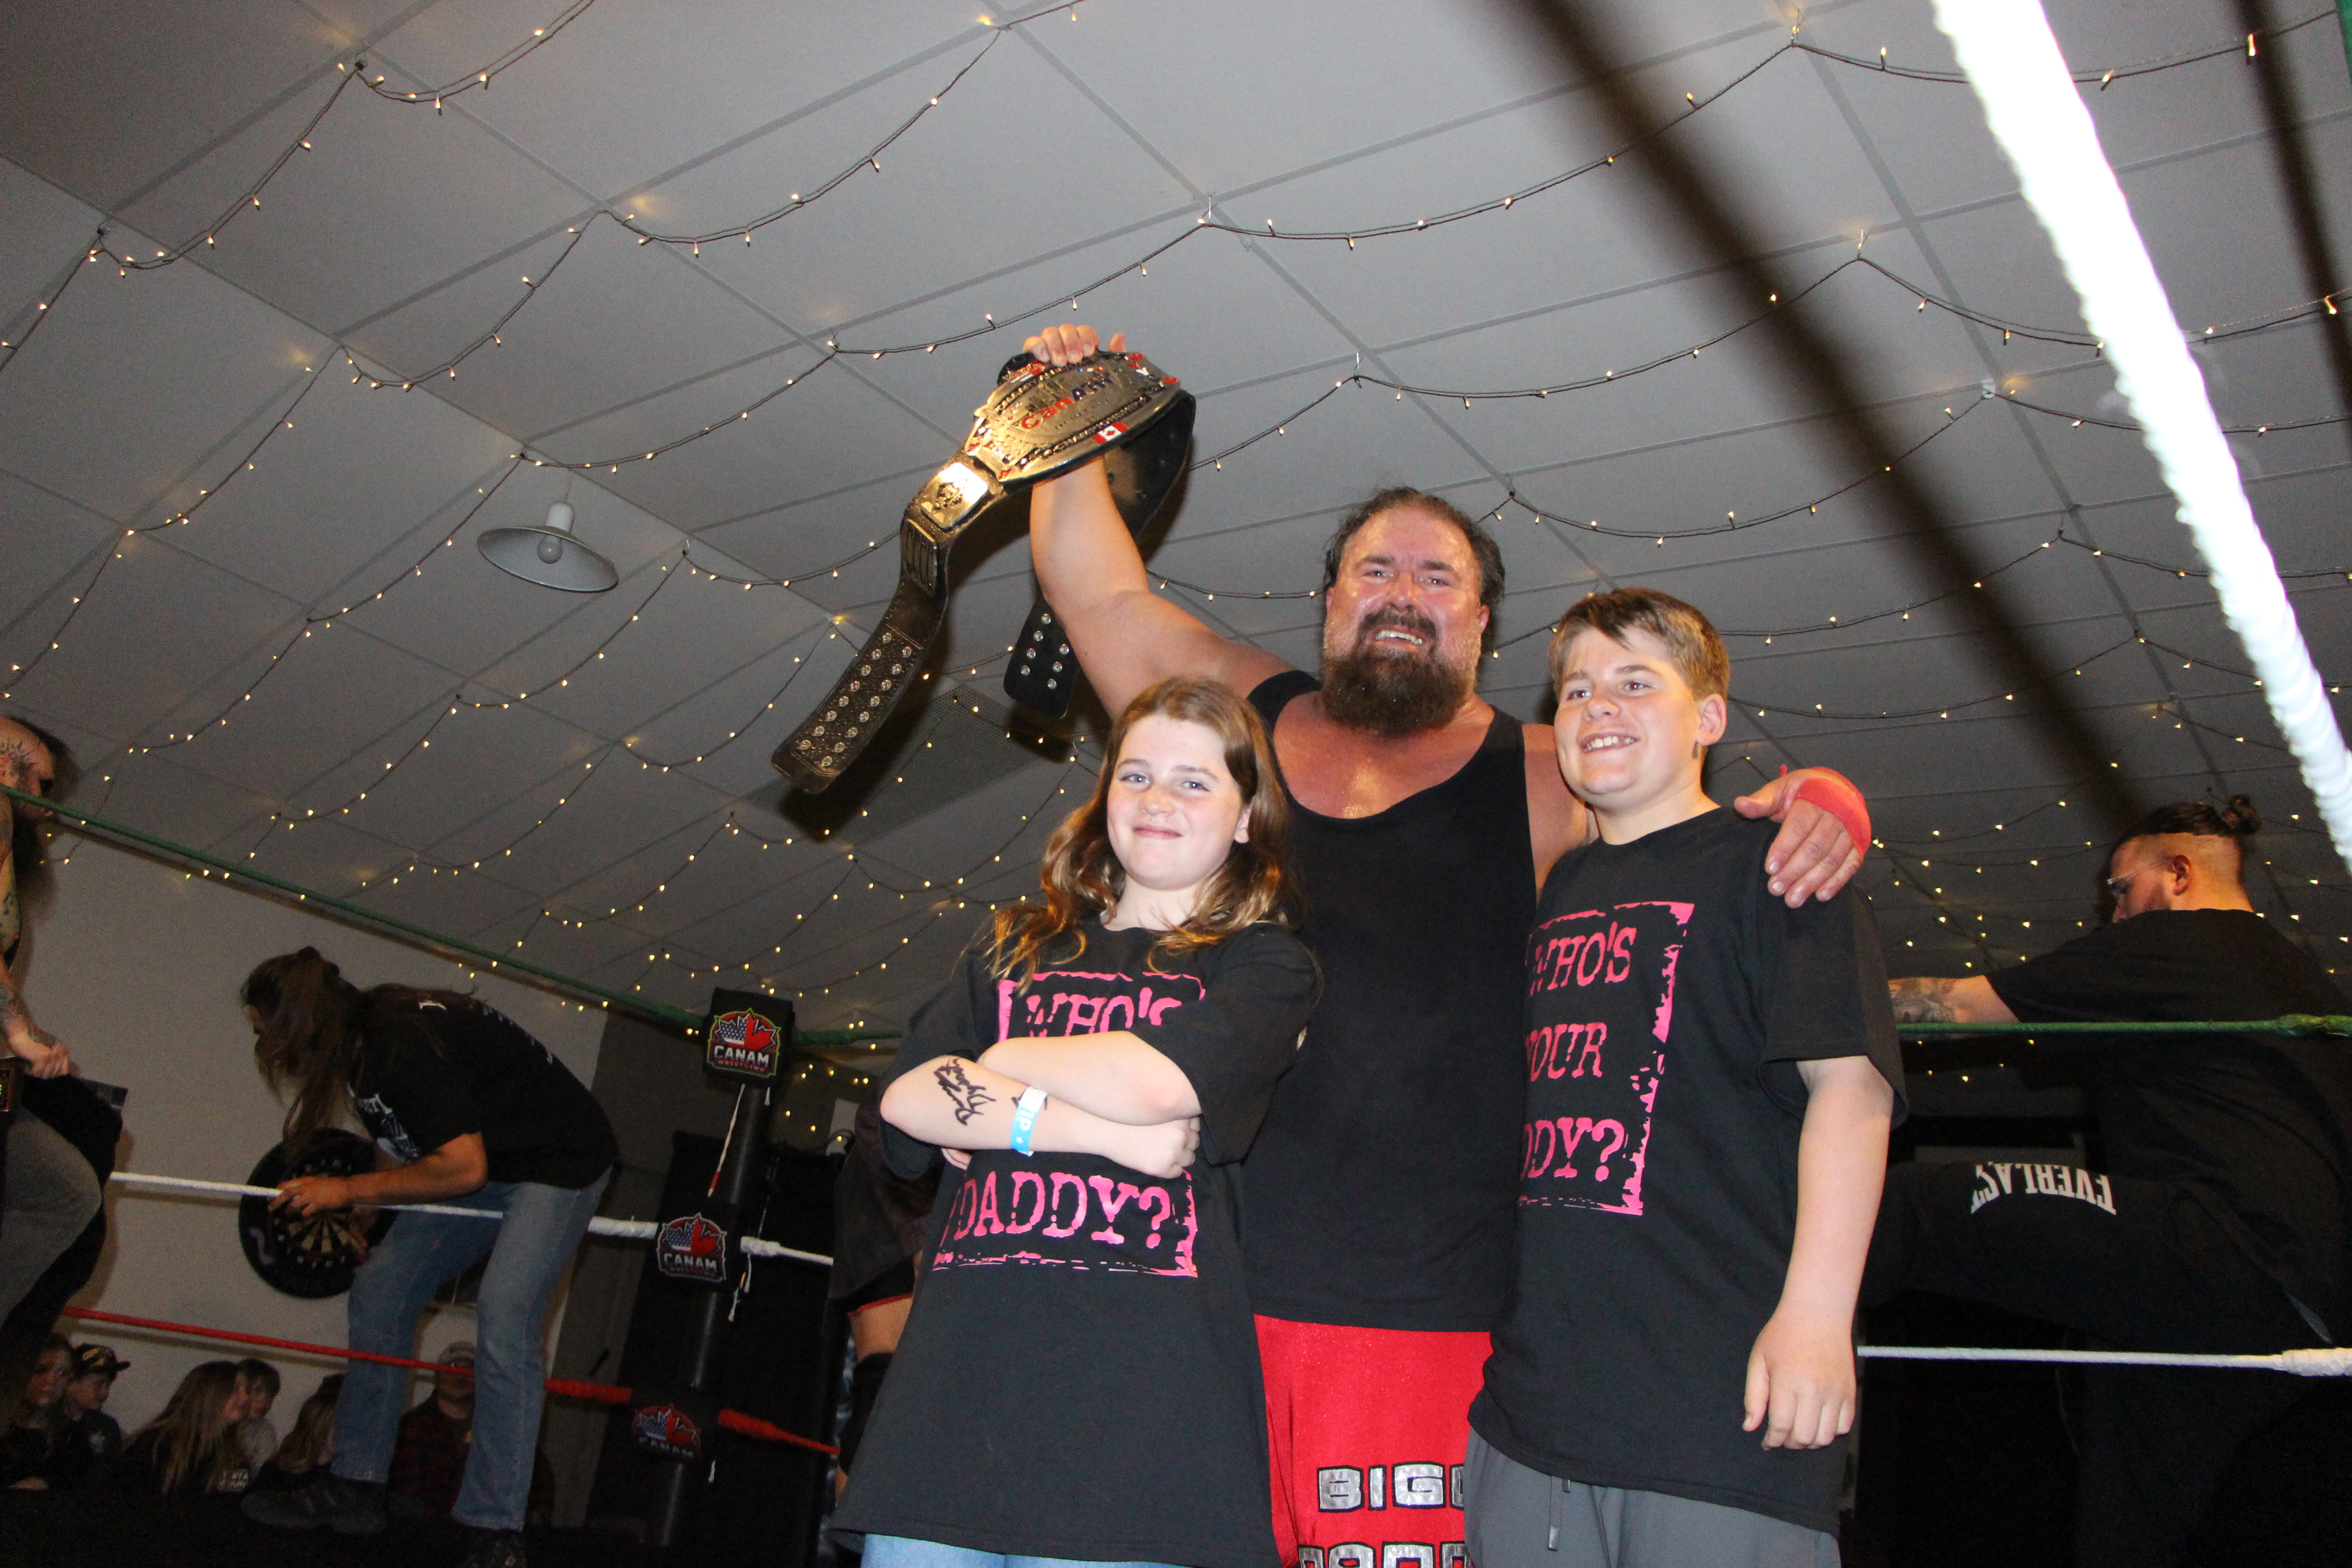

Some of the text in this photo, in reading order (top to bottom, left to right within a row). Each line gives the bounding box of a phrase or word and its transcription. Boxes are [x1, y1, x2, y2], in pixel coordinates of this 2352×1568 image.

[713, 1045, 770, 1068] CANAM
[1017, 1106, 1037, 1131] IP
[953, 1171, 1170, 1249] DADDY?
[664, 1252, 717, 1273] CANAM
[1318, 1461, 1464, 1512] BIG
